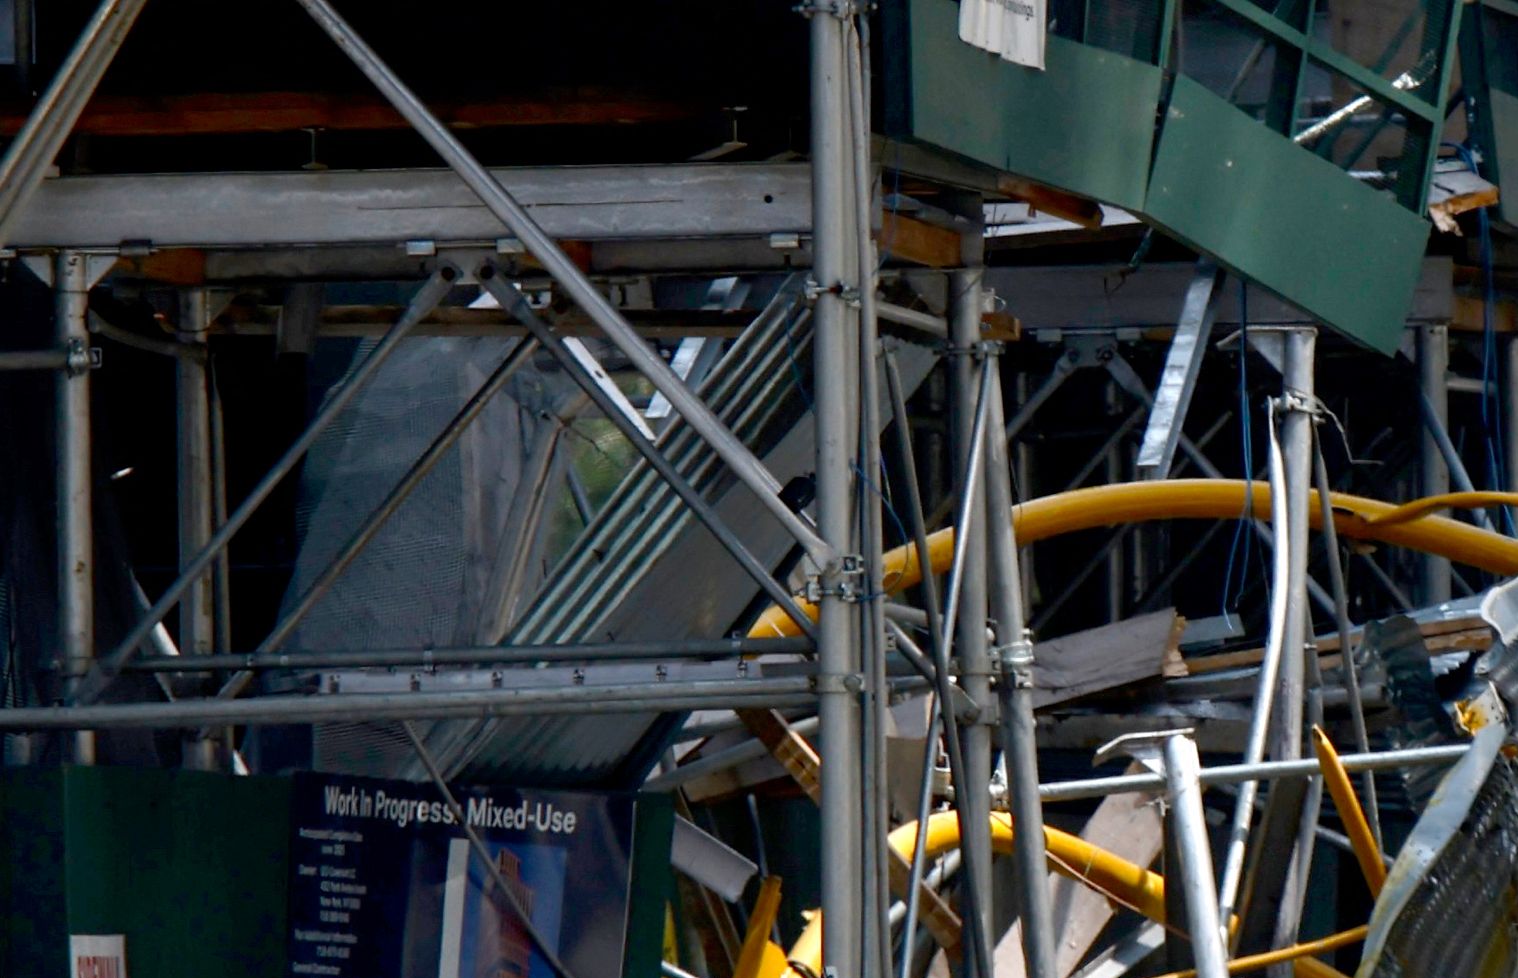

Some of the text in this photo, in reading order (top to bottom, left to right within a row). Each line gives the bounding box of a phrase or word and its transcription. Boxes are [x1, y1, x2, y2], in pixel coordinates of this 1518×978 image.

[325, 785, 577, 833] Work In Progress: Mixed-Use
